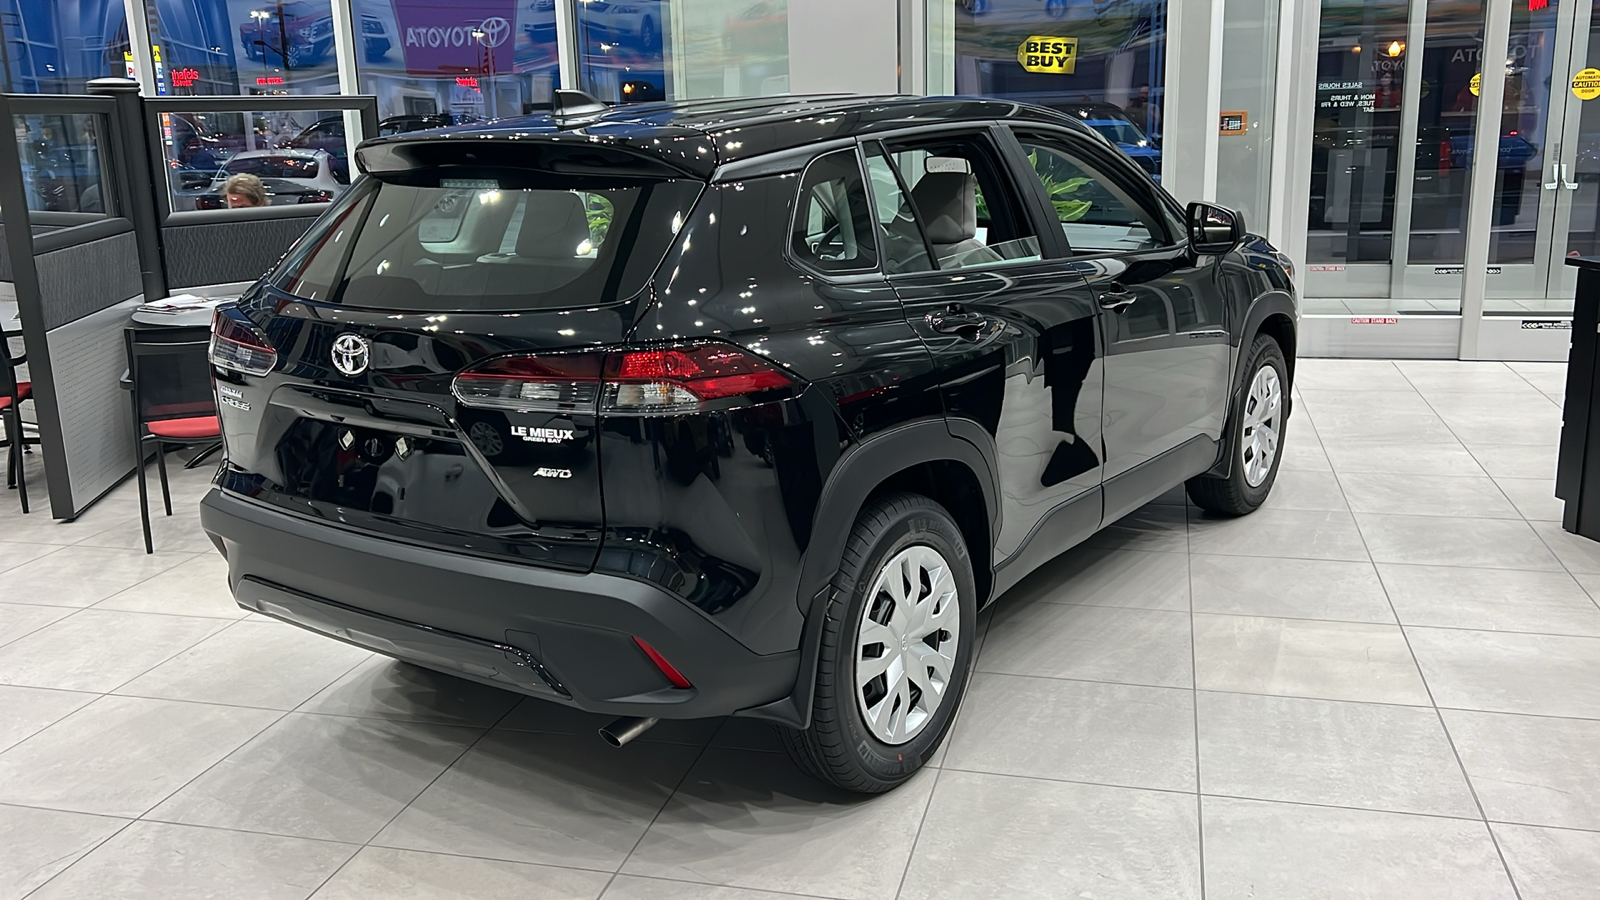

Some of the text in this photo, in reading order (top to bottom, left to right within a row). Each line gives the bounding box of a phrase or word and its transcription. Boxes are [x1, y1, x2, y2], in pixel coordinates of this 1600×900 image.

[1026, 41, 1075, 55] BEST
[1026, 55, 1069, 68] BUY
[221, 395, 251, 411] CROSS
[510, 425, 574, 440] LE MIEUX
[533, 467, 572, 479] AWD
